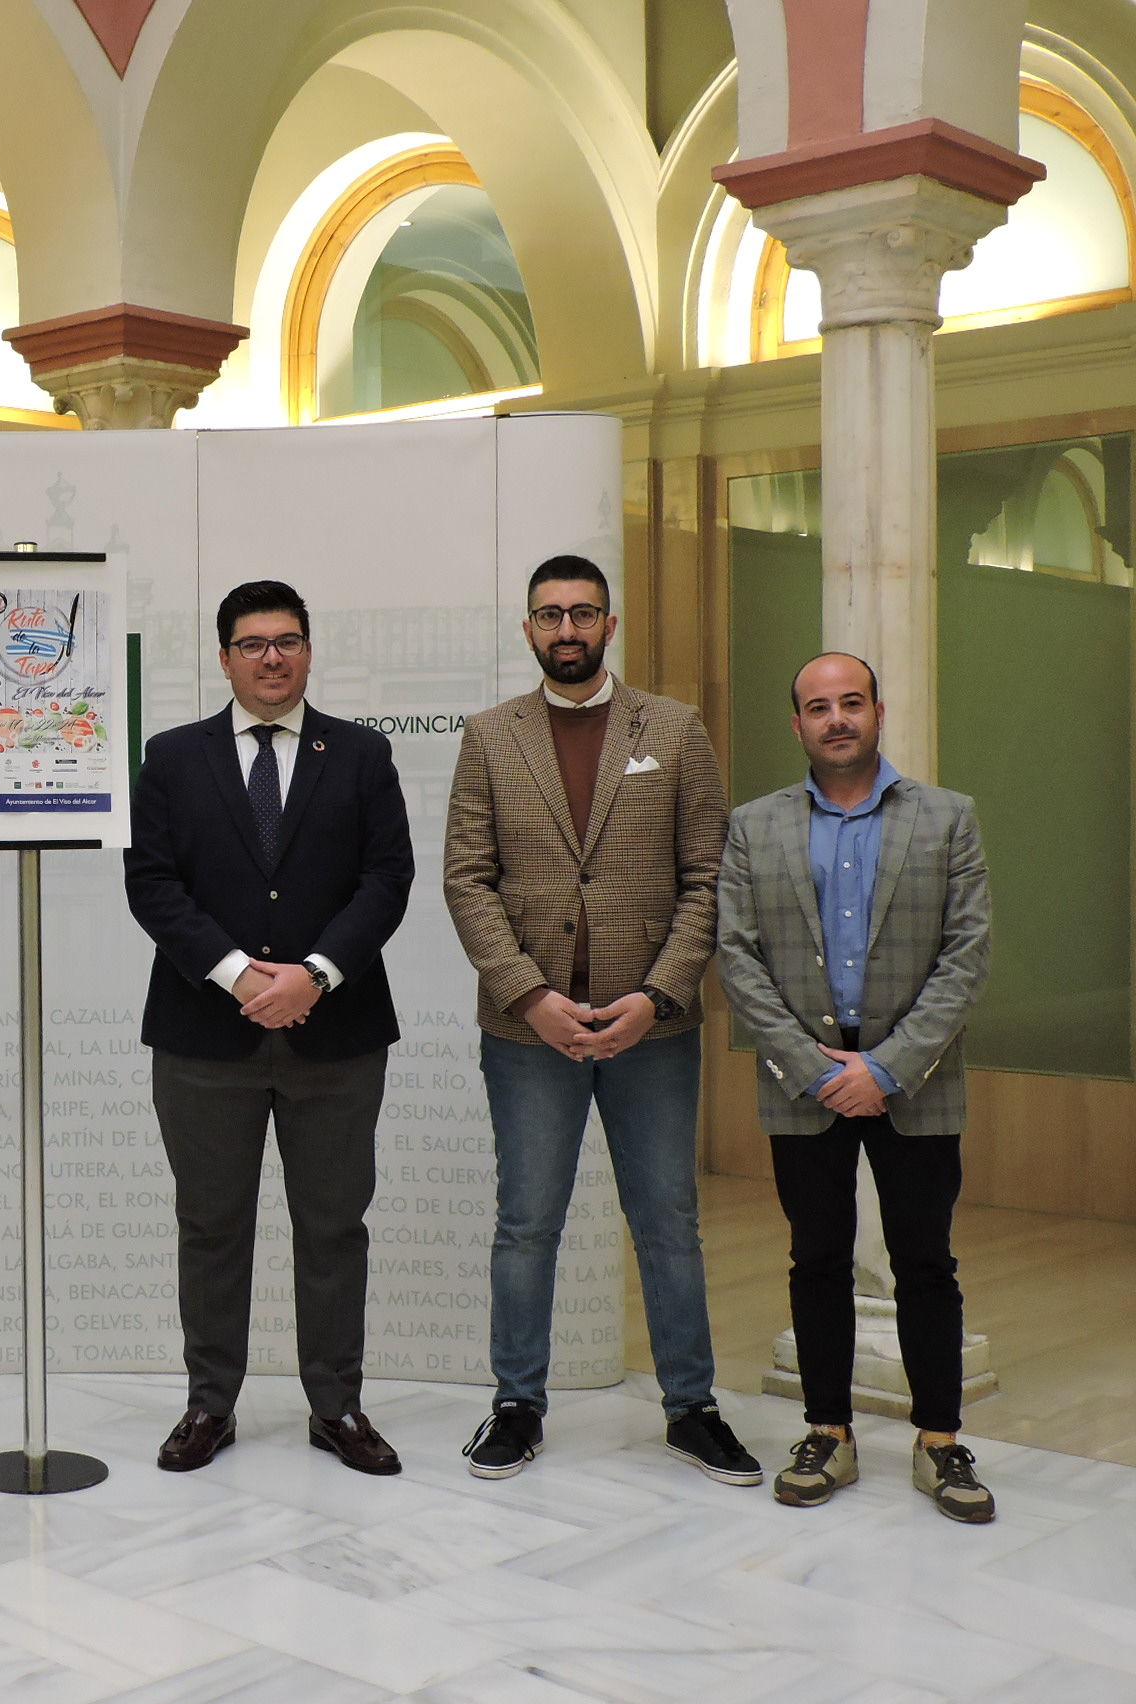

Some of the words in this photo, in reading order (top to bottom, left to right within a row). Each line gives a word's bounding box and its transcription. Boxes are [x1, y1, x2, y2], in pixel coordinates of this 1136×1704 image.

[8, 607, 46, 630] Ruta
[14, 656, 56, 679] Tapa
[5, 798, 44, 807] Ayuntamiento
[50, 1009, 136, 1025] CAZALLA
[413, 1010, 464, 1030] JARA,
[4, 1040, 72, 1058] RAL,
[80, 1039, 102, 1056] LA
[53, 1069, 124, 1088] MINAS,
[389, 1072, 424, 1089] DEL
[432, 1069, 472, 1095] RÍO,
[44, 1100, 94, 1119] ORIPE,
[101, 1100, 152, 1117] MON
[44, 1128, 103, 1148] ARTÍN
[112, 1130, 137, 1147] DE
[395, 1135, 414, 1151] EL
[50, 1161, 124, 1181] UTRERA,
[131, 1160, 164, 1177] LAS
[401, 1166, 420, 1182] EL
[99, 1192, 119, 1208] EL
[416, 1197, 440, 1214] DE
[448, 1198, 485, 1216] LOS
[81, 1223, 105, 1239] DE
[112, 1222, 179, 1239] GUADA
[372, 1224, 461, 1249] LCÓLLAR,
[47, 1253, 116, 1271] LGABA,
[125, 1252, 177, 1269] SANT
[369, 1258, 449, 1279] LIVARES,
[69, 1280, 176, 1300] BENACAZÓ
[74, 1314, 149, 1333] GELVES,
[383, 1321, 482, 1345] ALJARAFE,
[72, 1344, 174, 1364] TOMARES,
[364, 1350, 415, 1369] CINA
[426, 1352, 452, 1371] DE
[464, 1355, 487, 1373] LA
